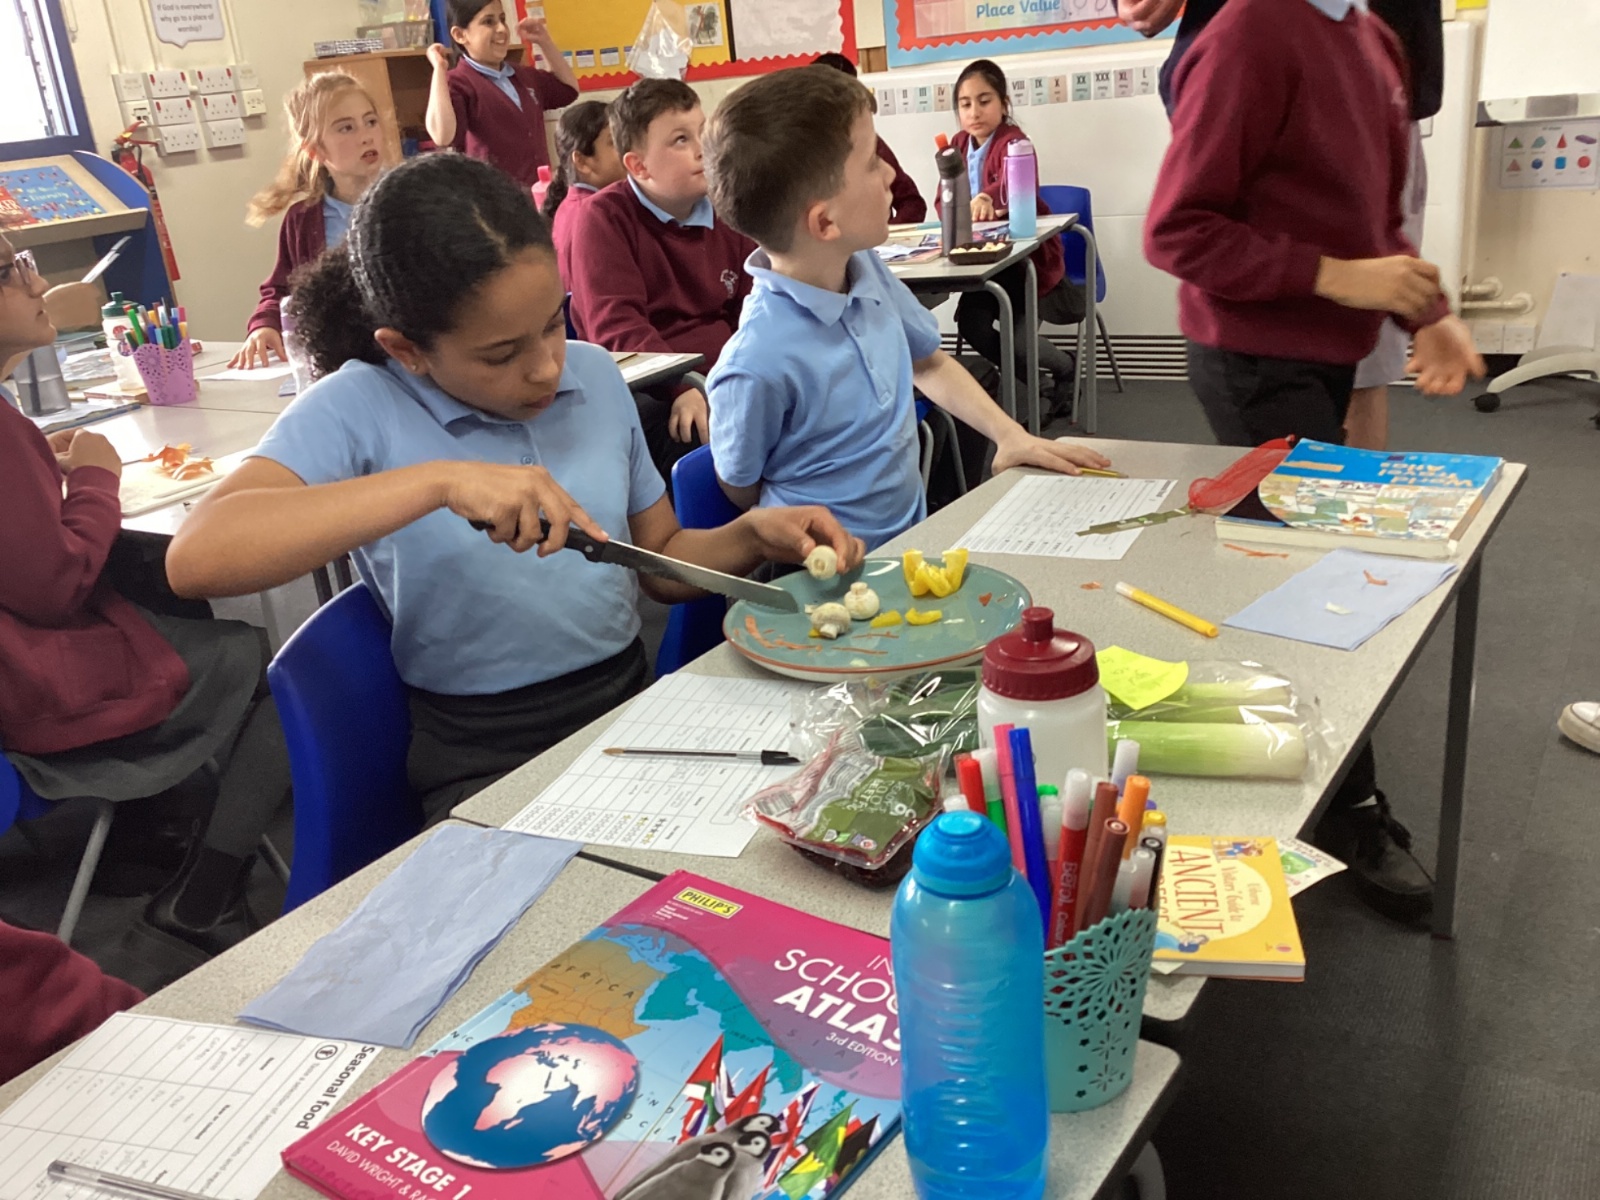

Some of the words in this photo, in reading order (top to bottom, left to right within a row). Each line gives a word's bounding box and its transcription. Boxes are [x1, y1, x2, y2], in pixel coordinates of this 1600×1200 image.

[975, 4, 1015, 18] Place
[1019, 0, 1061, 13] Value
[682, 891, 735, 914] PHILIP'S
[1168, 850, 1225, 934] ANCIENT
[825, 1032, 850, 1047] 3rd
[846, 1039, 899, 1067] EDITION
[322, 1045, 376, 1099] Seasonal
[294, 1099, 331, 1131] food
[325, 1139, 362, 1164] DAVID
[357, 1158, 404, 1190] WRIGHT
[397, 1183, 413, 1195] &
[345, 1122, 394, 1152] KEY
[384, 1146, 457, 1192] STAGE
[451, 1184, 473, 1200] 1
